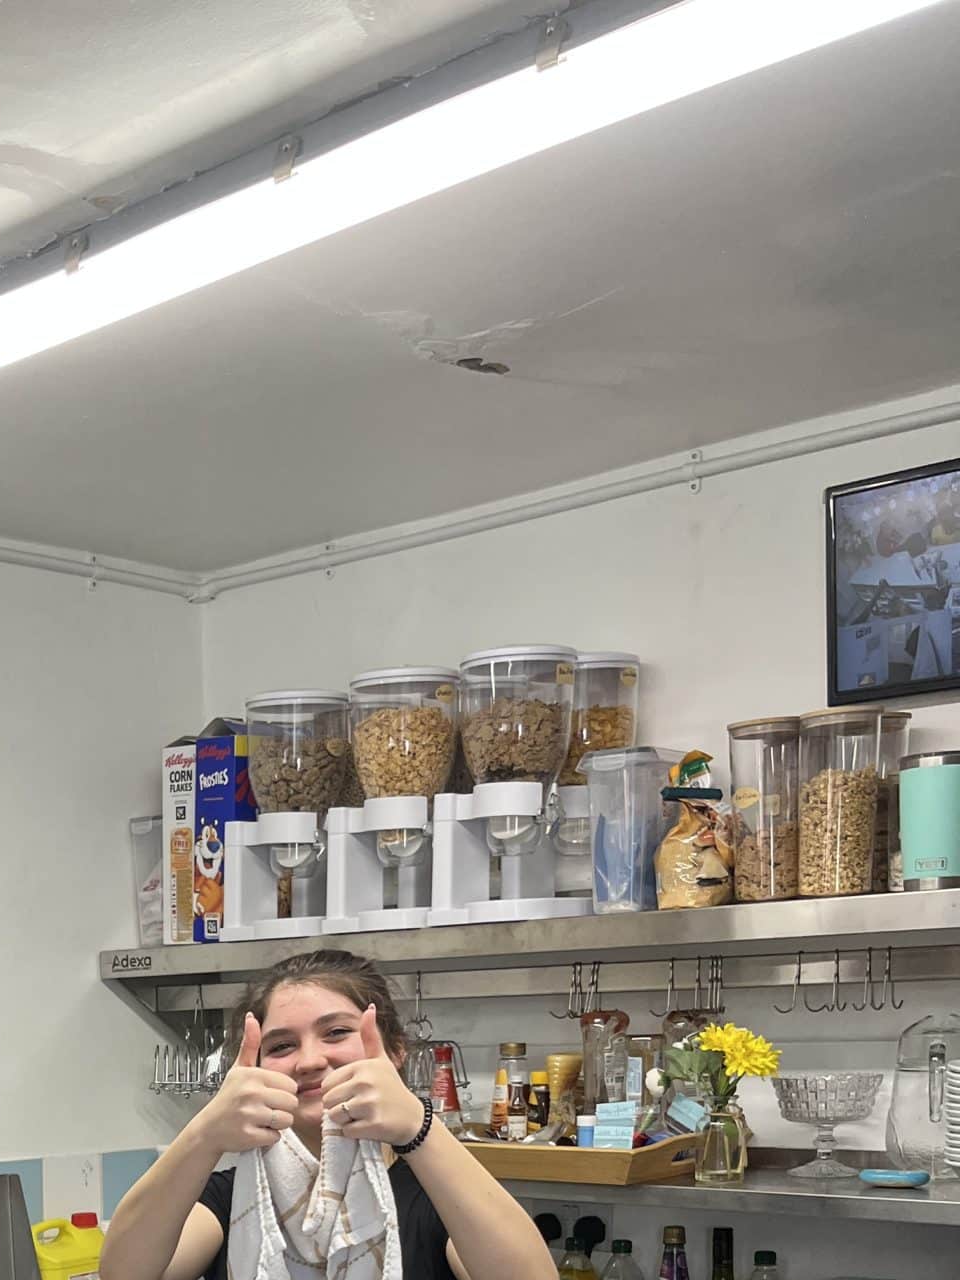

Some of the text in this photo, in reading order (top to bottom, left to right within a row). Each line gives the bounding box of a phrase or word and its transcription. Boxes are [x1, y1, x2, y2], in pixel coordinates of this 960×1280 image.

[169, 769, 193, 783] CORN
[199, 768, 229, 791] FROSTIES
[169, 783, 193, 792] FLAKES
[111, 954, 152, 969] Adexa
